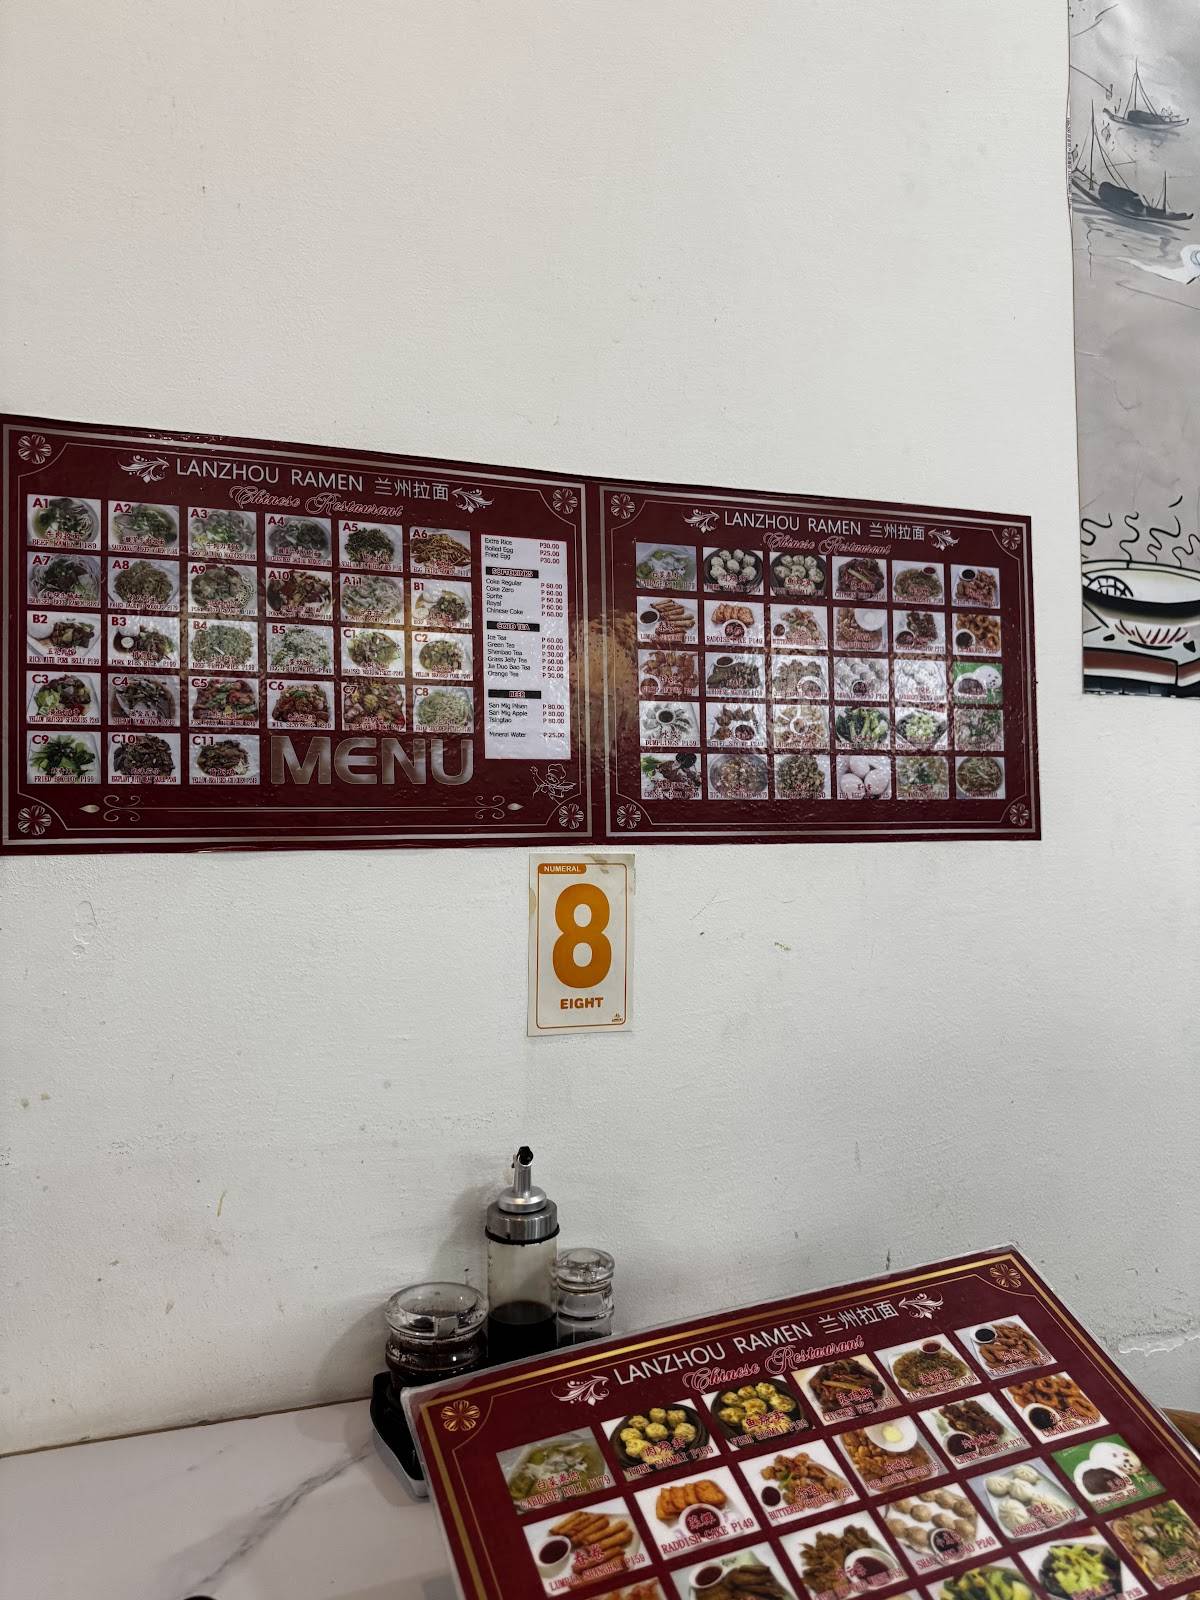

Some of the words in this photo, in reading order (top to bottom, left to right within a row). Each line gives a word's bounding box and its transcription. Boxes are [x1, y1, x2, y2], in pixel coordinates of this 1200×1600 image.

[176, 458, 279, 483] LANZHOU
[291, 469, 363, 492] RAMEN
[374, 476, 449, 501] 兰州拉面
[33, 498, 49, 508] A1
[229, 485, 301, 509] Chinese
[305, 492, 403, 517] Restaurant
[113, 503, 131, 513] A2
[190, 509, 208, 519] A3
[268, 517, 284, 526] A4
[724, 511, 800, 531] LANZHOU
[808, 519, 861, 535] RAMEN
[869, 522, 925, 542] 兰州拉面
[343, 523, 358, 531] A5
[413, 529, 428, 538] A6
[762, 532, 815, 551] Chinese
[818, 536, 890, 555] Restaurant
[32, 555, 50, 565] A7
[112, 560, 129, 569] A8
[191, 565, 205, 574] A9
[268, 571, 290, 580] A10
[413, 582, 424, 591] B1
[32, 614, 48, 624] B2
[111, 617, 127, 626] B3
[193, 621, 208, 630] B4
[272, 625, 286, 634] B5
[343, 629, 356, 638] C1
[414, 634, 428, 642] C2
[32, 674, 48, 684] C3
[112, 676, 128, 686] C4
[192, 678, 208, 688] C5
[269, 681, 284, 690] C6
[343, 685, 357, 694] C7
[415, 687, 429, 696] C8
[32, 734, 49, 744] C9
[111, 734, 136, 744] C10
[192, 736, 215, 745] C11
[271, 736, 473, 785] MENU
[552, 883, 612, 988] 8
[560, 997, 603, 1010] EIGHT
[613, 1343, 724, 1385] LANZHOU
[733, 1322, 813, 1353] RAMEN
[819, 1300, 899, 1335] 兰州拉面
[683, 1362, 760, 1395] Chinese
[765, 1334, 865, 1375] Restaurant
[767, 1502, 804, 1520] BUTTERED
[660, 1533, 702, 1554] RADDISH
[703, 1525, 729, 1540] CAKE
[729, 1516, 755, 1532] P149
[973, 1535, 997, 1550] P249
